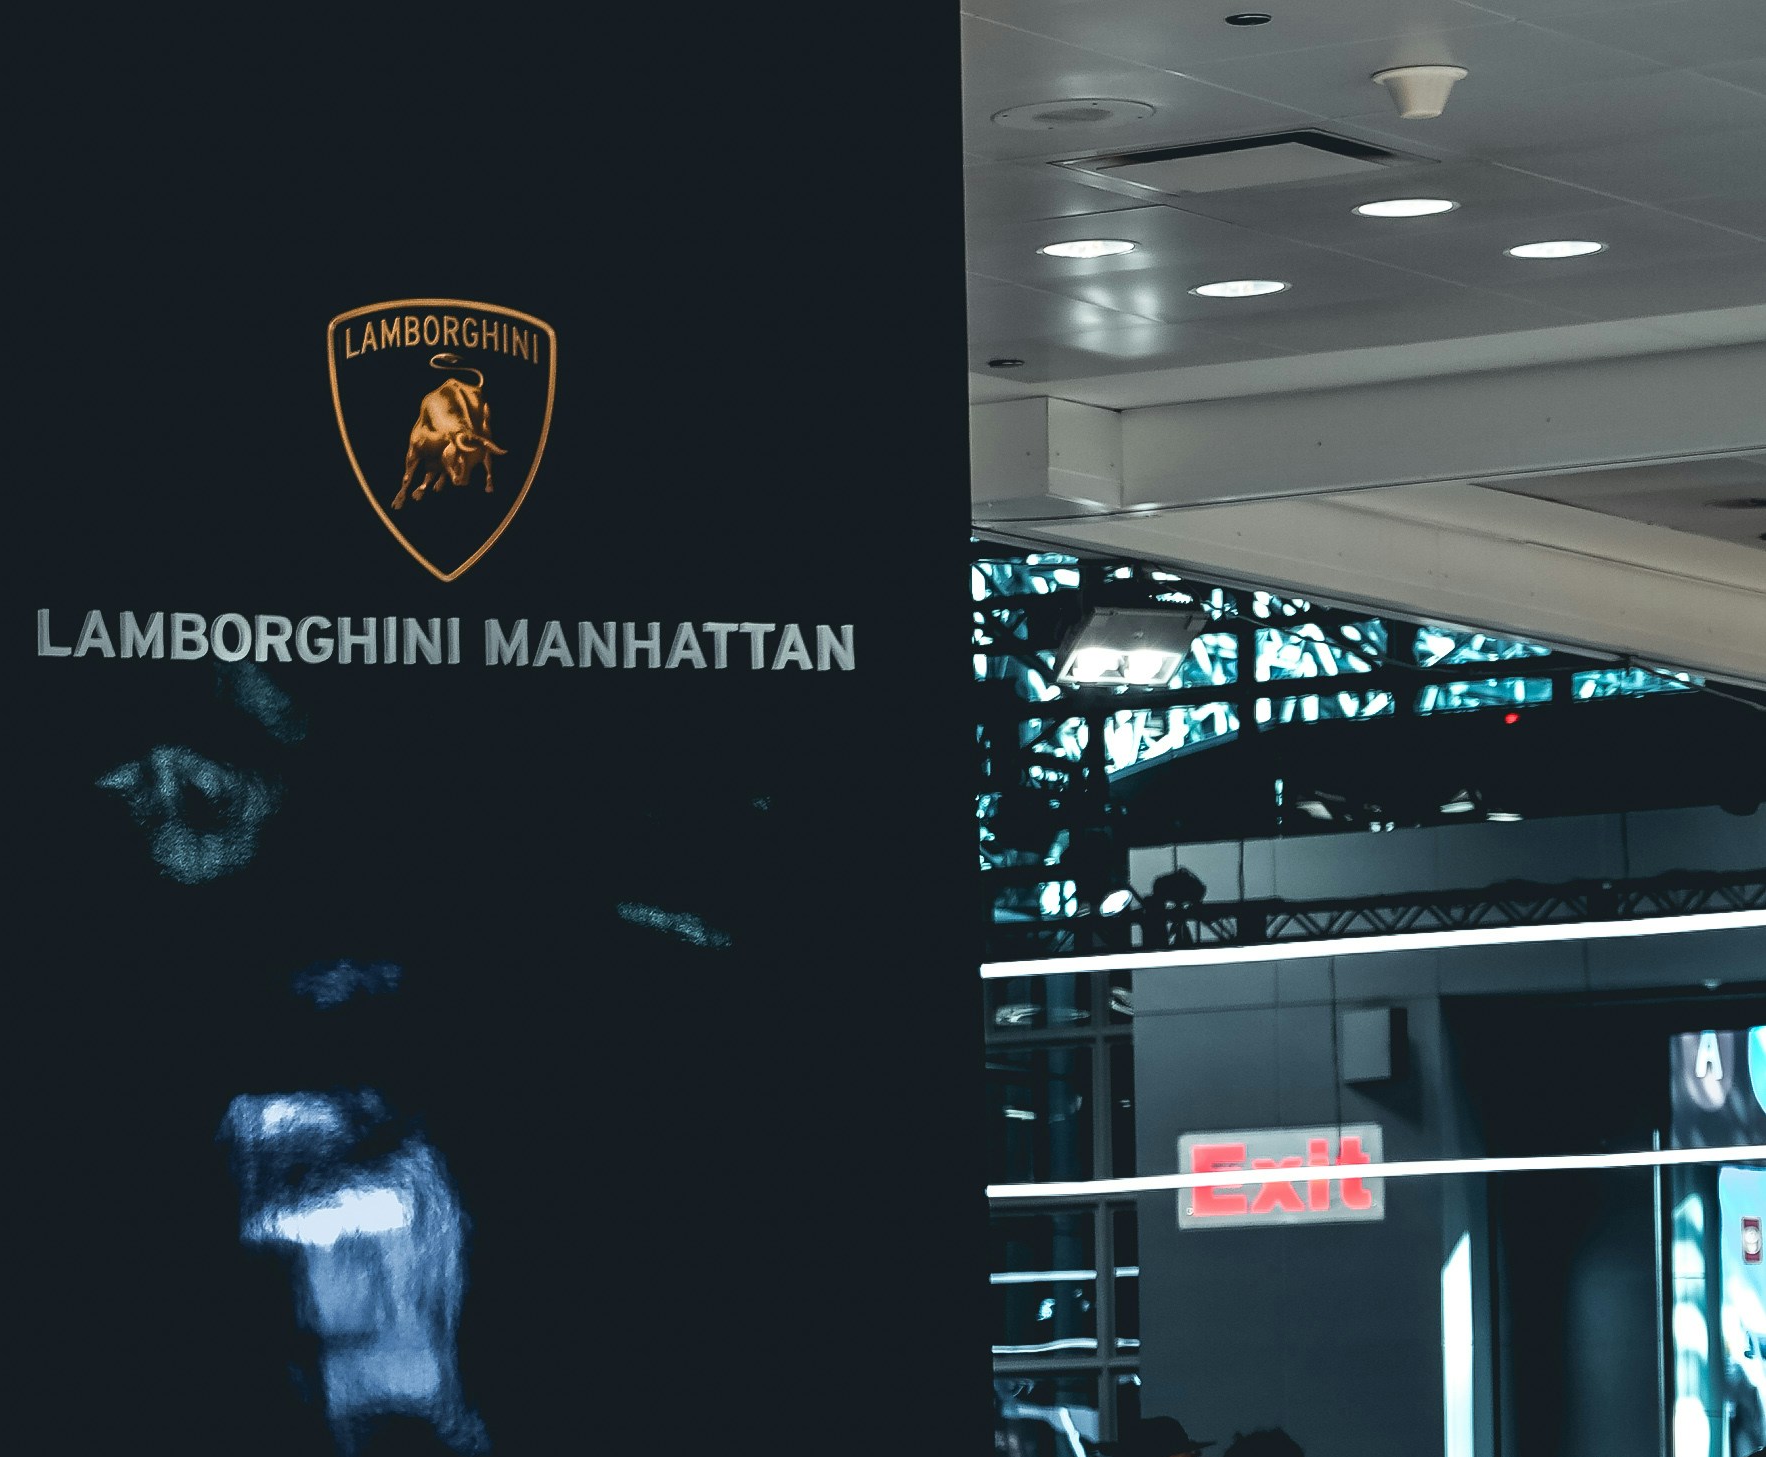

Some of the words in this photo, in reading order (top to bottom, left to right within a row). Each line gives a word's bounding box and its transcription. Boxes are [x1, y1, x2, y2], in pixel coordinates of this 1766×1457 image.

[344, 314, 540, 365] LAMBORGHINI
[37, 609, 461, 665] LAMBORGHINI
[484, 617, 856, 671] MANHATTAN
[1190, 1136, 1374, 1217] Exit
